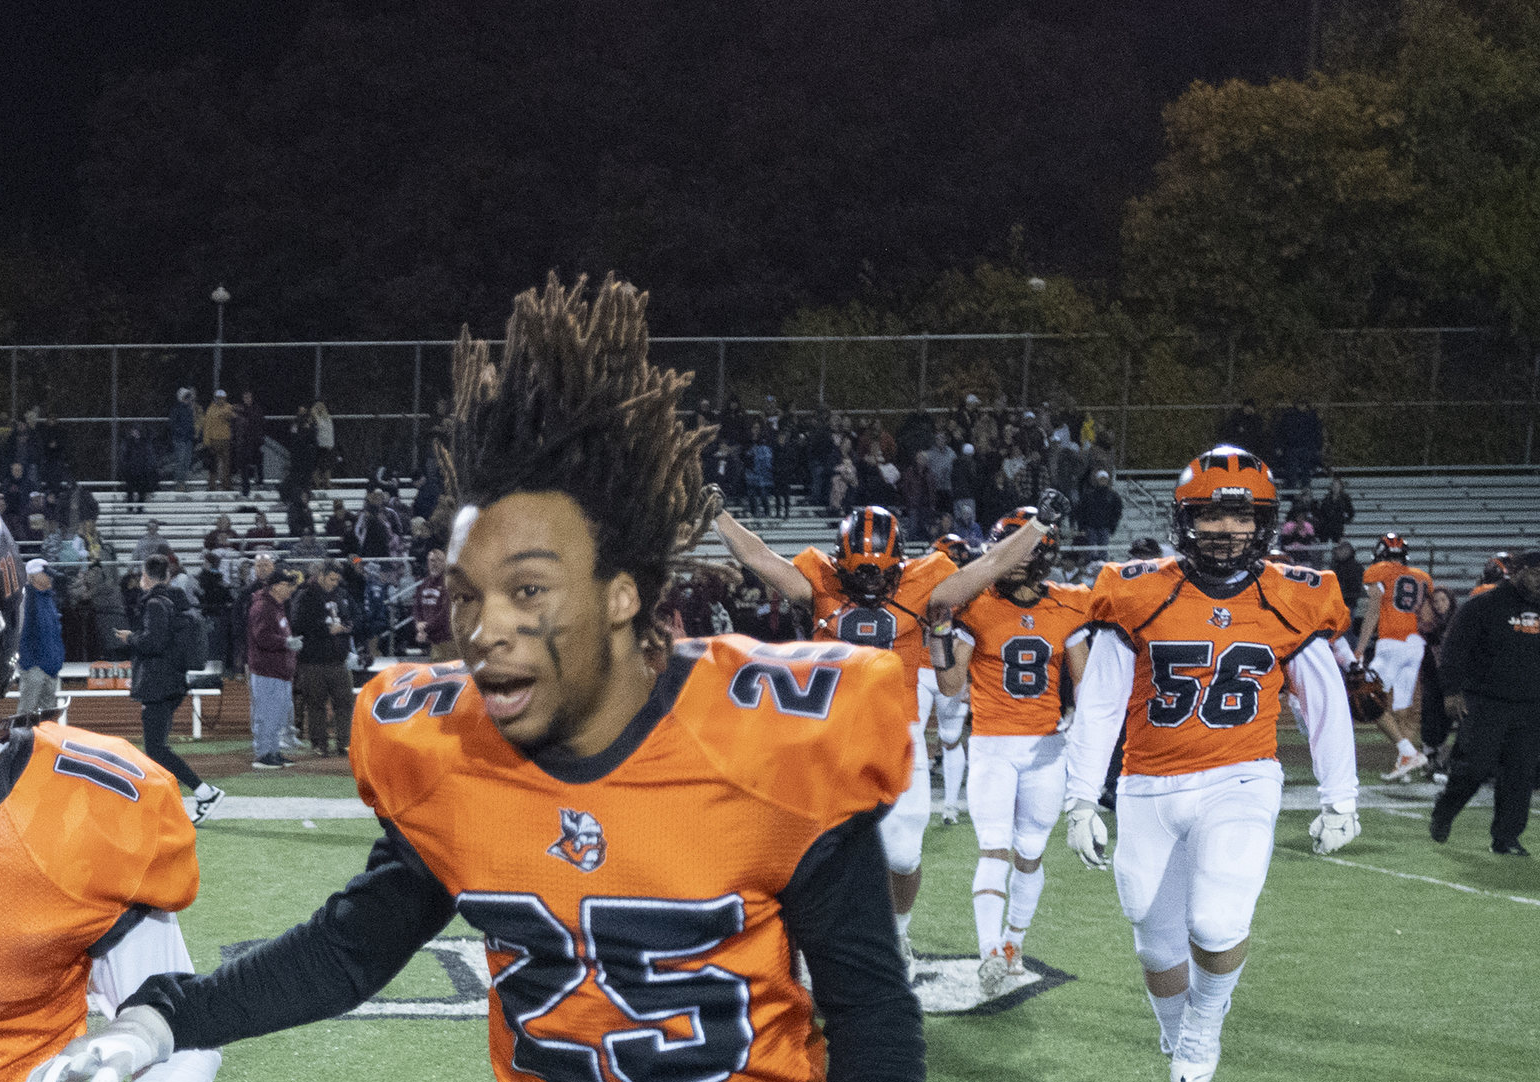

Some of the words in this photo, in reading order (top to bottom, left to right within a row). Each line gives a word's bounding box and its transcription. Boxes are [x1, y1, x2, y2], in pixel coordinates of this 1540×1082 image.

[0, 552, 20, 598] 11
[1000, 636, 1053, 698] 8
[1147, 640, 1276, 728] 56
[53, 739, 146, 802] 11
